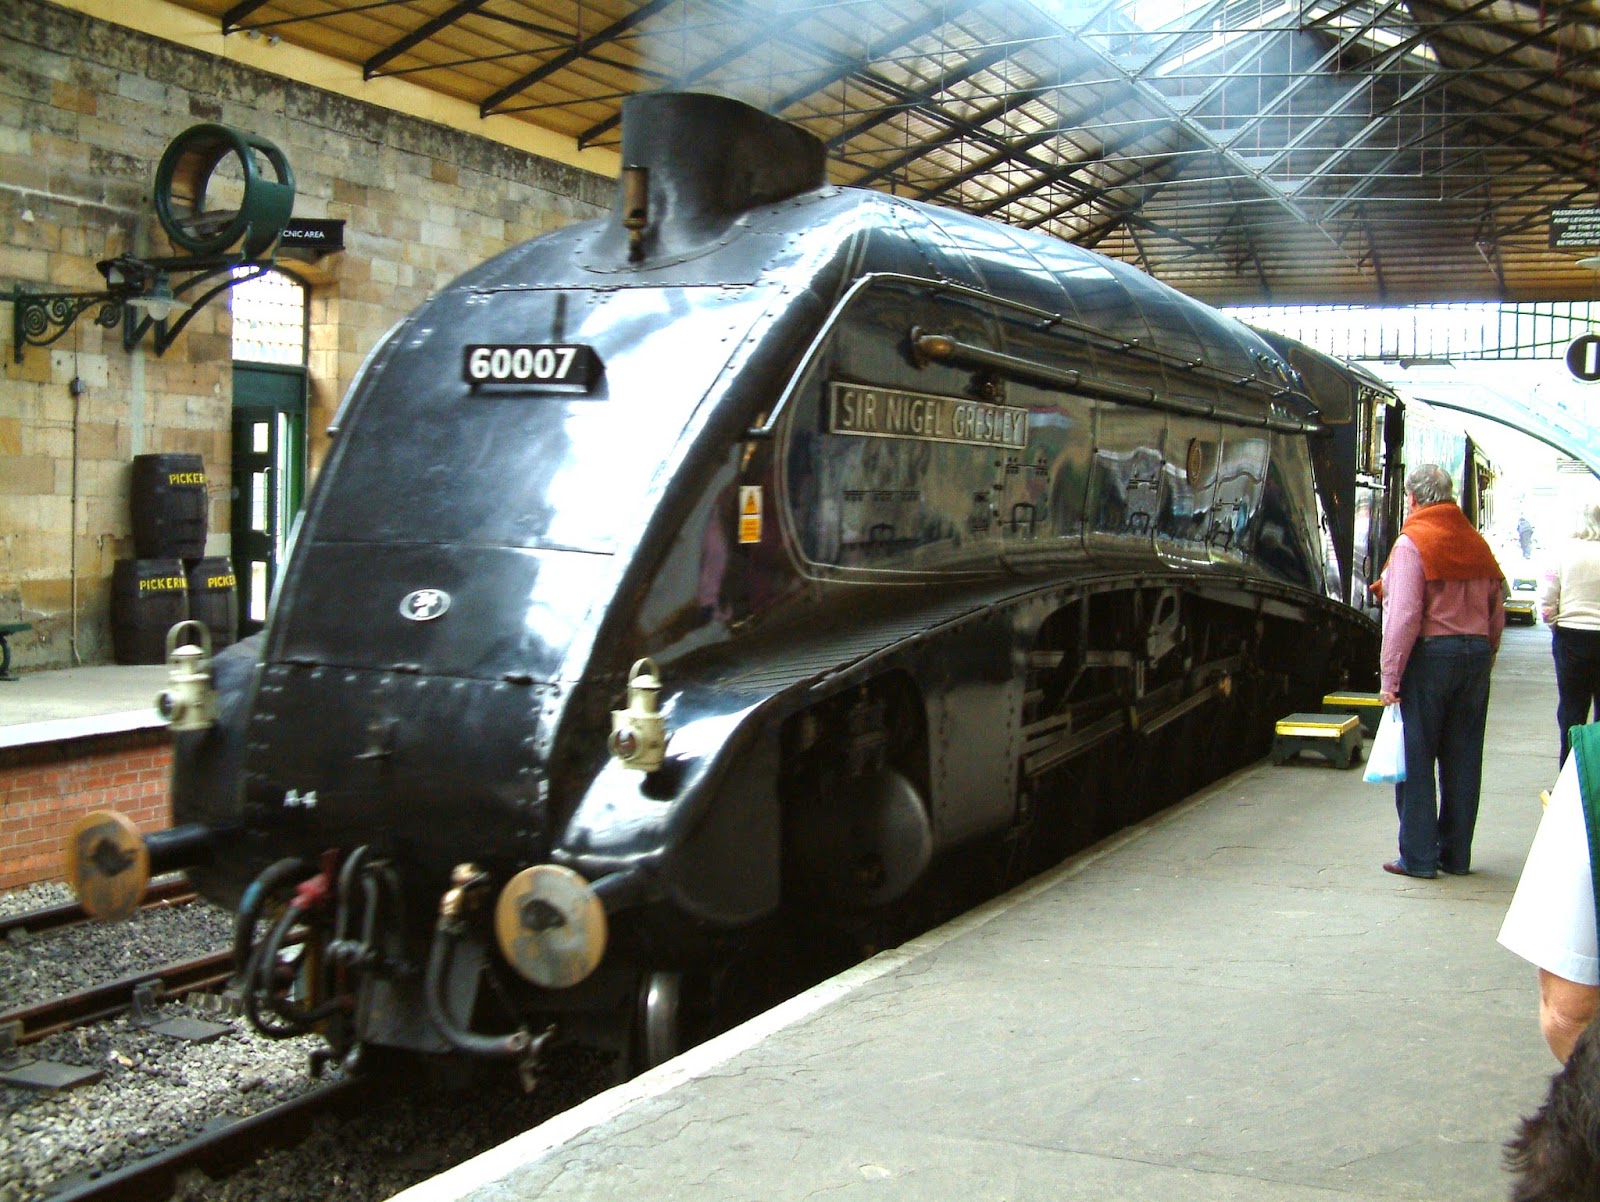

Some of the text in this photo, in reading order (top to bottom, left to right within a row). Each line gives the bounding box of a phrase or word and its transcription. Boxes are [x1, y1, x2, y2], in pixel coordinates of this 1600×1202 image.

[283, 229, 325, 239] CNIC AREA
[470, 347, 578, 379] 60007
[842, 390, 1025, 445] SIR NIGEL GRESLEY
